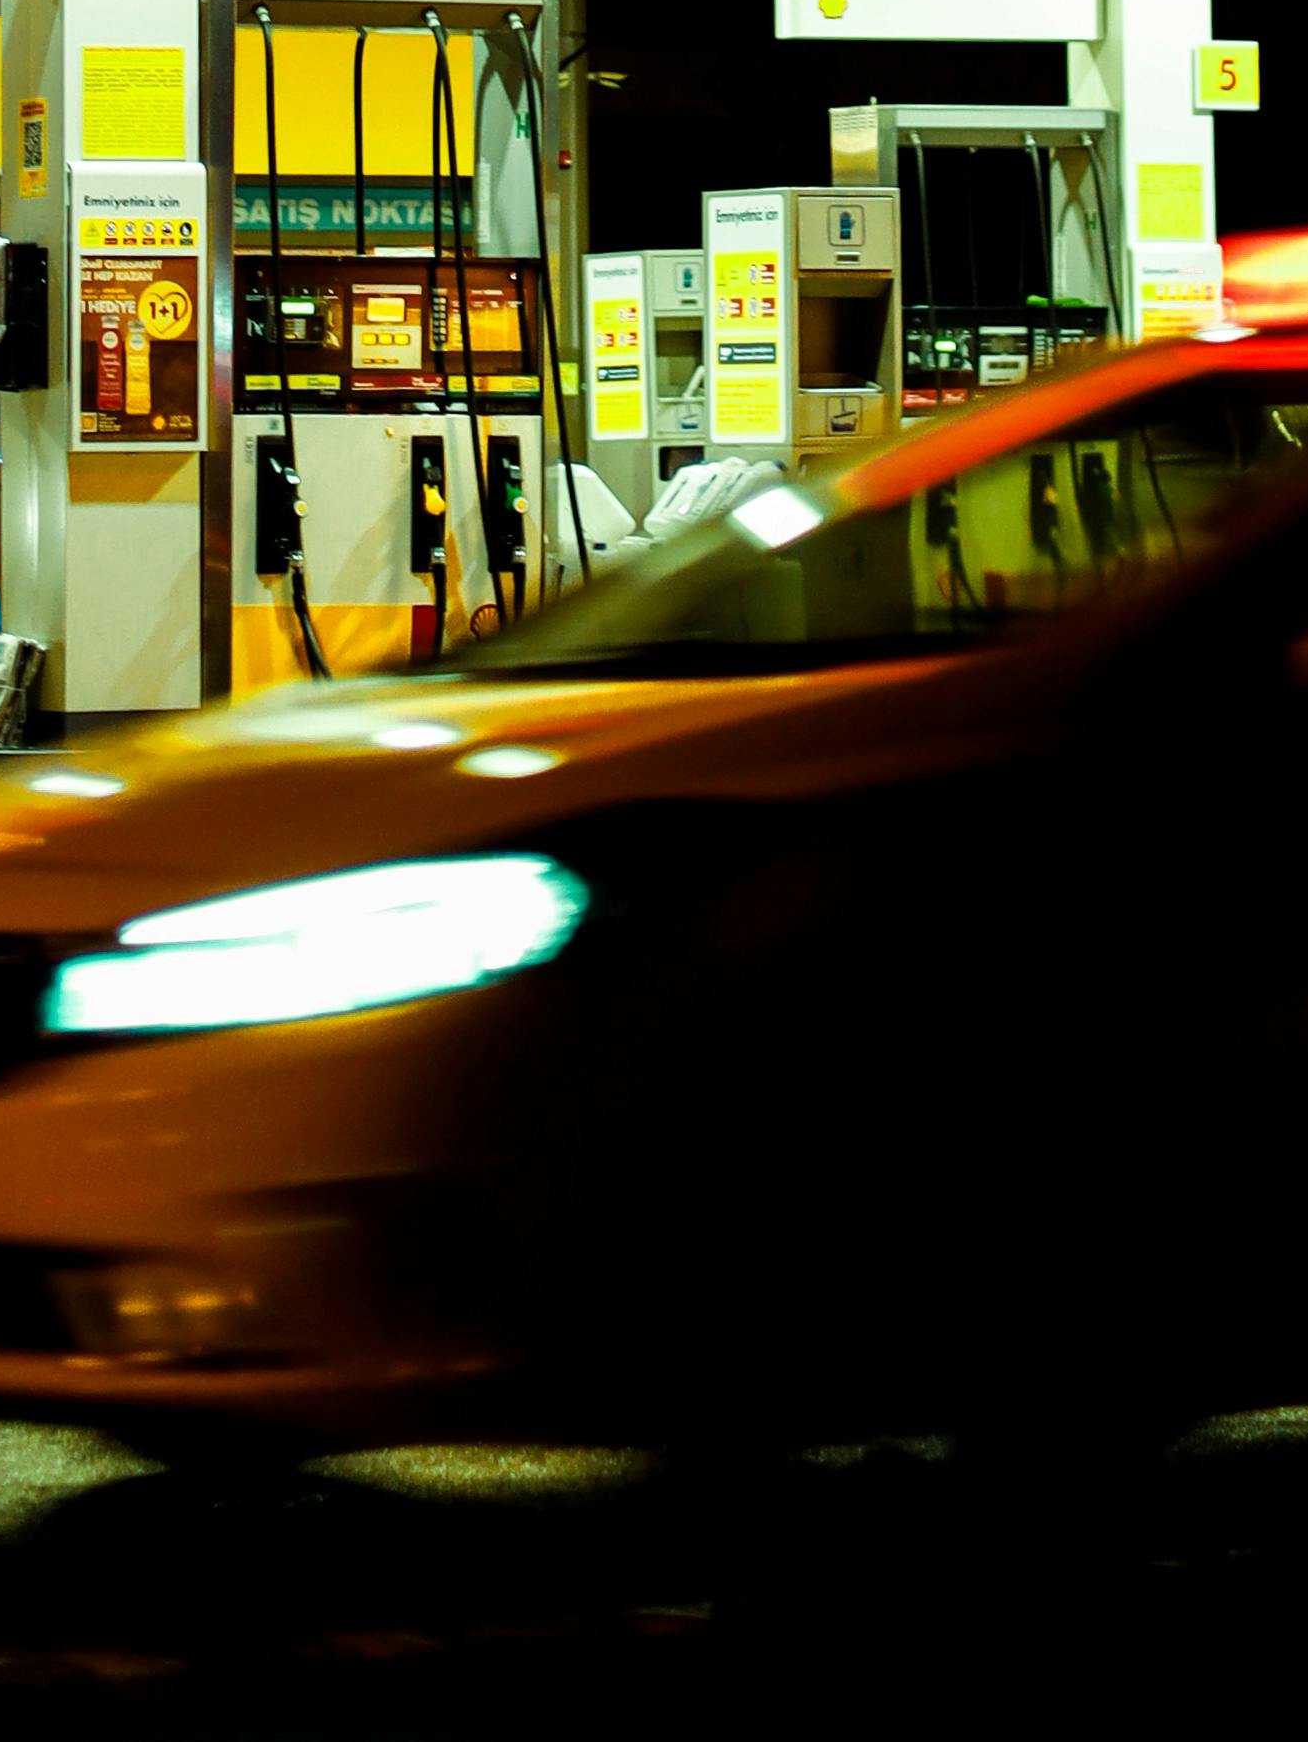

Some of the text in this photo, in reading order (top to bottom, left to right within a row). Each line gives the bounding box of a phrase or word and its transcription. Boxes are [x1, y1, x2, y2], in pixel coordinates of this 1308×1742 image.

[1219, 59, 1237, 91] 5
[83, 195, 180, 210] Emniyetiniz için
[233, 198, 321, 230] SATIŞ
